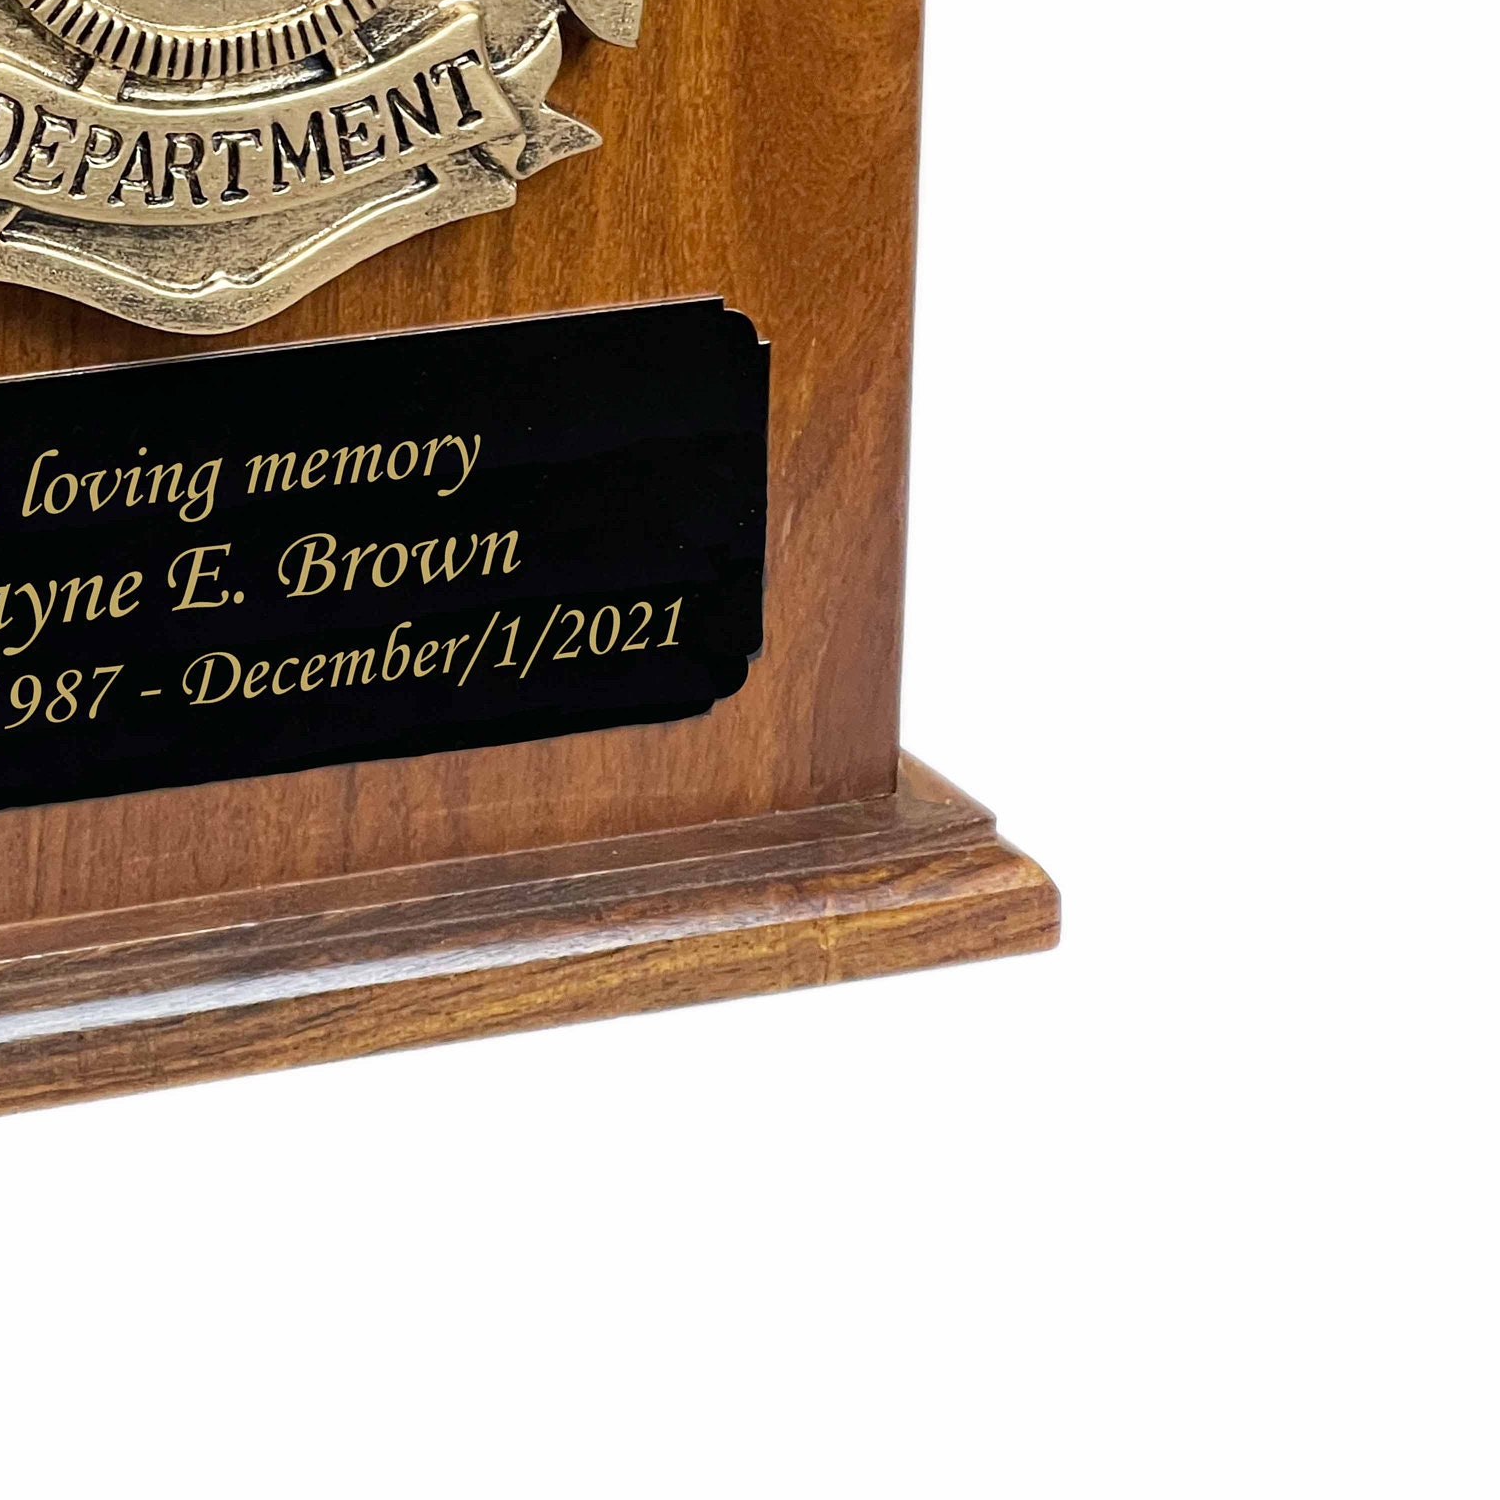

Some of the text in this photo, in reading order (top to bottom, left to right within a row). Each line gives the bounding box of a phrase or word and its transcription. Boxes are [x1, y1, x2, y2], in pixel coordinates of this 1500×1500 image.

[20, 447, 225, 524] loving
[244, 432, 483, 498] memory
[166, 541, 246, 613] E.
[276, 528, 523, 600] Brown
[180, 595, 684, 707] December/1/2021
